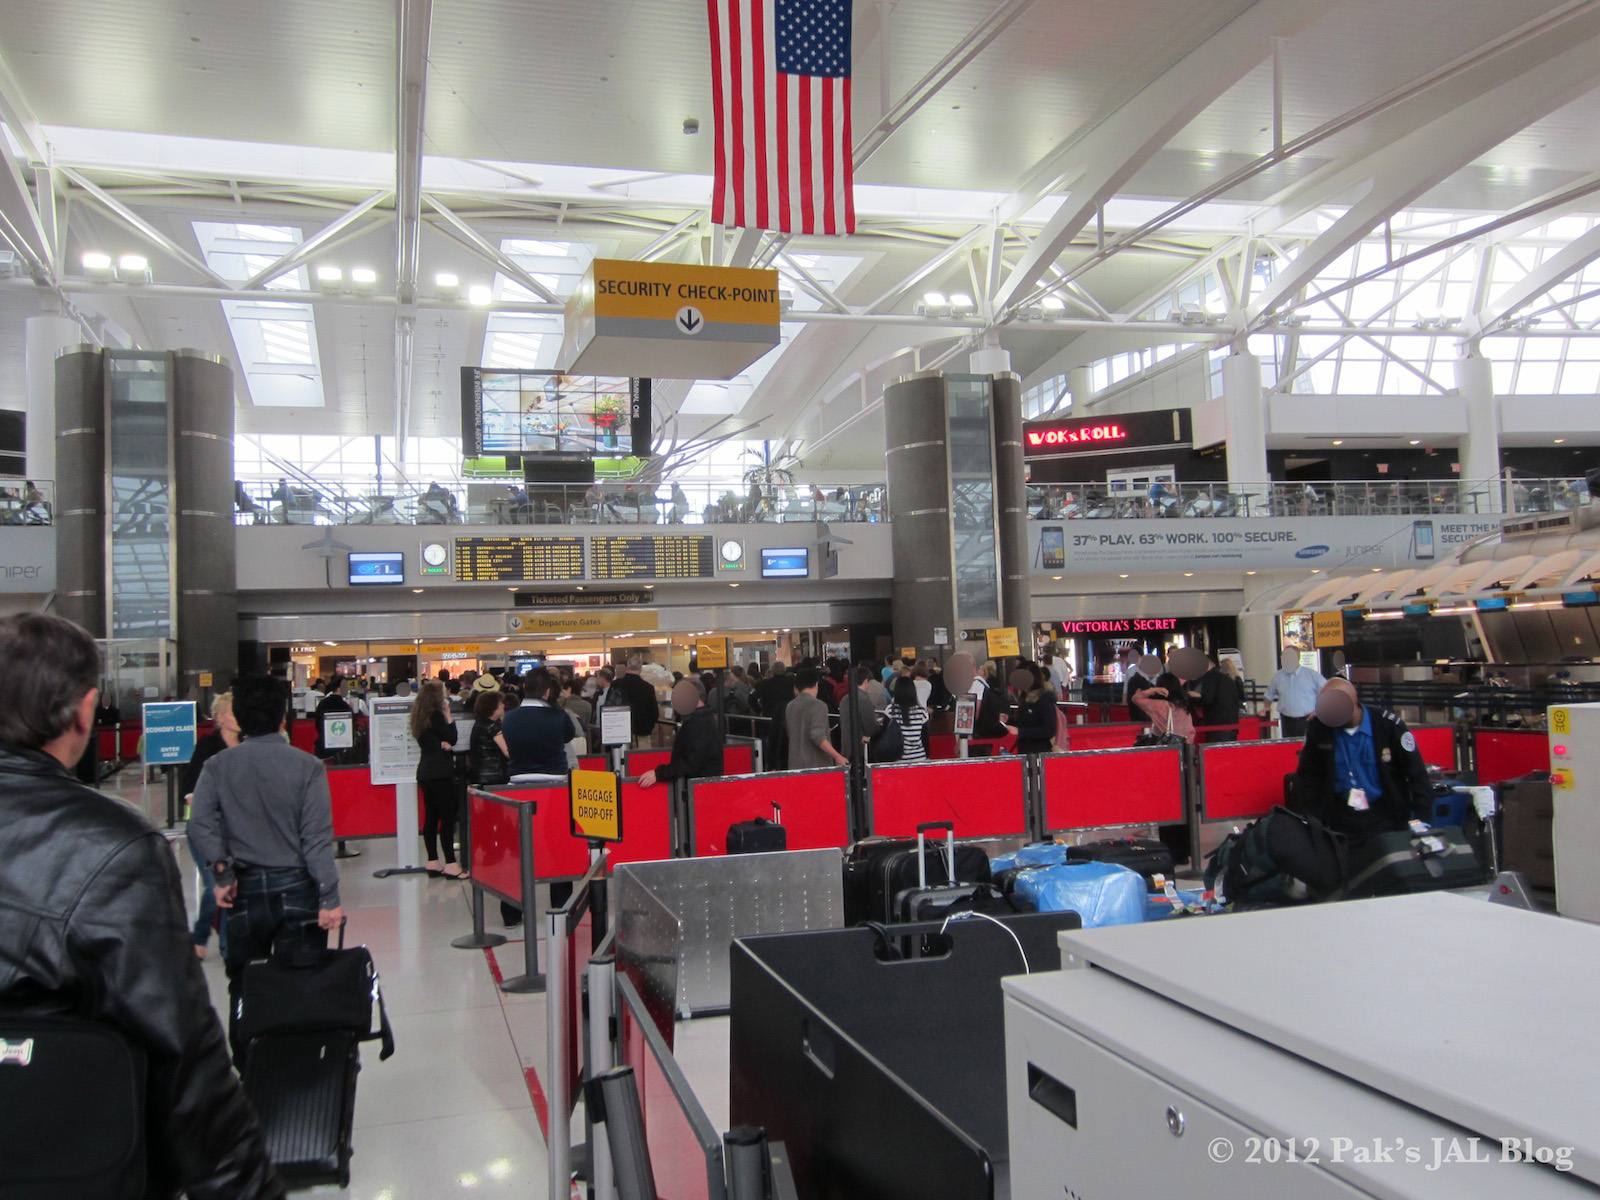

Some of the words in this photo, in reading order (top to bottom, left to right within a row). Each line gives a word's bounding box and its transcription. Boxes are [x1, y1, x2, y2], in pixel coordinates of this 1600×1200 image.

[598, 279, 672, 297] SECURITY
[677, 284, 776, 303] CHECK-POINT
[632, 377, 640, 403] ERMINAL
[632, 404, 640, 418] ONE
[1440, 524, 1468, 534] MEET
[1470, 523, 1490, 533] THE
[1073, 534, 1097, 546] 37%
[1099, 534, 1135, 546] PLAY.
[1139, 533, 1164, 545] 63%
[1166, 532, 1208, 545] WORK.
[1212, 531, 1243, 544] 100%
[1244, 531, 1297, 543] SECURE.
[531, 595, 568, 604] Ticketed
[569, 593, 617, 605] Passengers
[620, 592, 640, 603] Only
[538, 618, 577, 628] Departure
[579, 618, 602, 626] Gates
[1062, 620, 1130, 633] VICTORIA'S
[1134, 618, 1177, 631] SECRET
[1317, 620, 1341, 629] BAGGAGE
[1317, 630, 1341, 638] DROP-OFF
[577, 788, 613, 803] BAGGAGE
[578, 806, 613, 820] DROP-OFF
